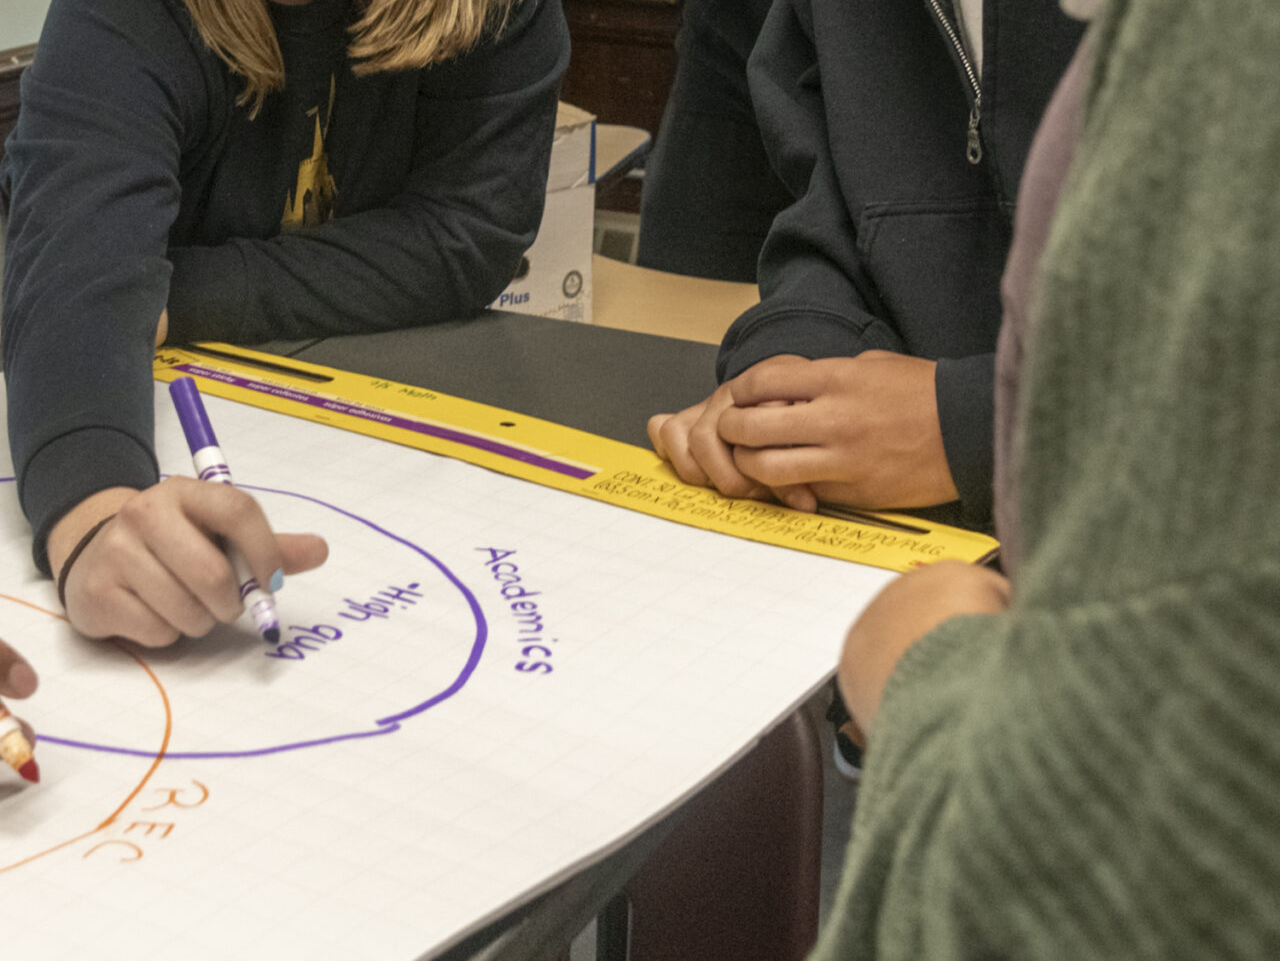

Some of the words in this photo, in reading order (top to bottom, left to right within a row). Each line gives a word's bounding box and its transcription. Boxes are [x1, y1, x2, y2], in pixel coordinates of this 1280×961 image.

[499, 292, 530, 307] Plus
[337, 583, 424, 622] High
[473, 546, 558, 675] Academics
[81, 779, 210, 864] REC
